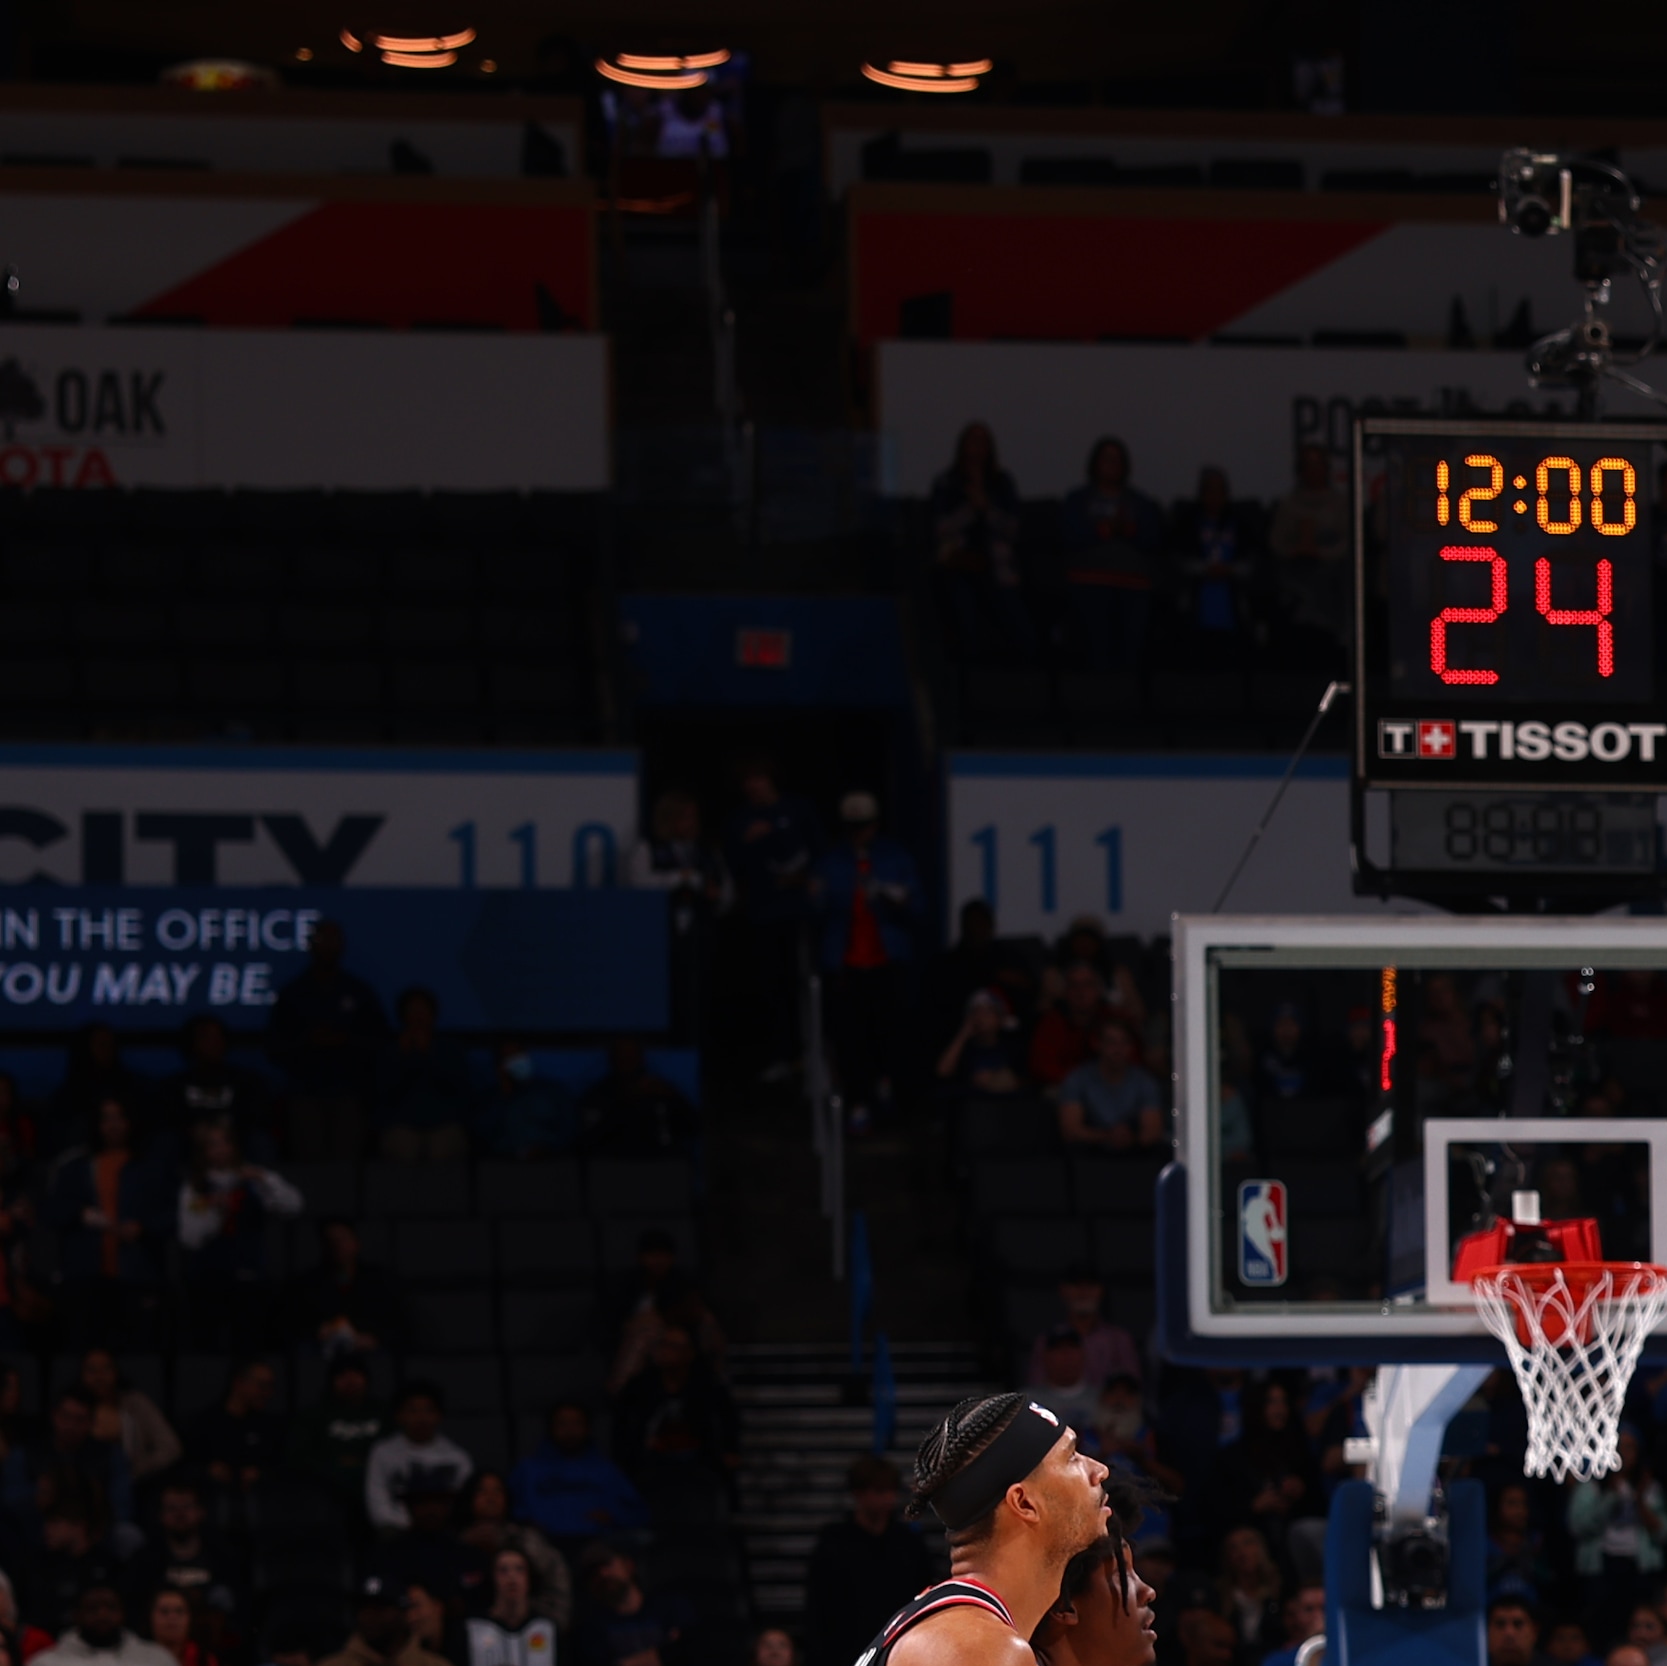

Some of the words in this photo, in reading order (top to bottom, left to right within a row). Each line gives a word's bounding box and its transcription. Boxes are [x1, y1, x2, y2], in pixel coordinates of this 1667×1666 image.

[56, 369, 166, 435] OAK
[1436, 453, 1637, 537] 12:00
[1429, 544, 1615, 687] 24
[0, 810, 386, 888] CITY
[450, 821, 618, 890] 110
[971, 825, 1123, 912] 111
[52, 907, 145, 951] THE
[155, 907, 323, 952] OFFICE
[92, 962, 202, 1006] MAY
[207, 962, 280, 1006] BE.
